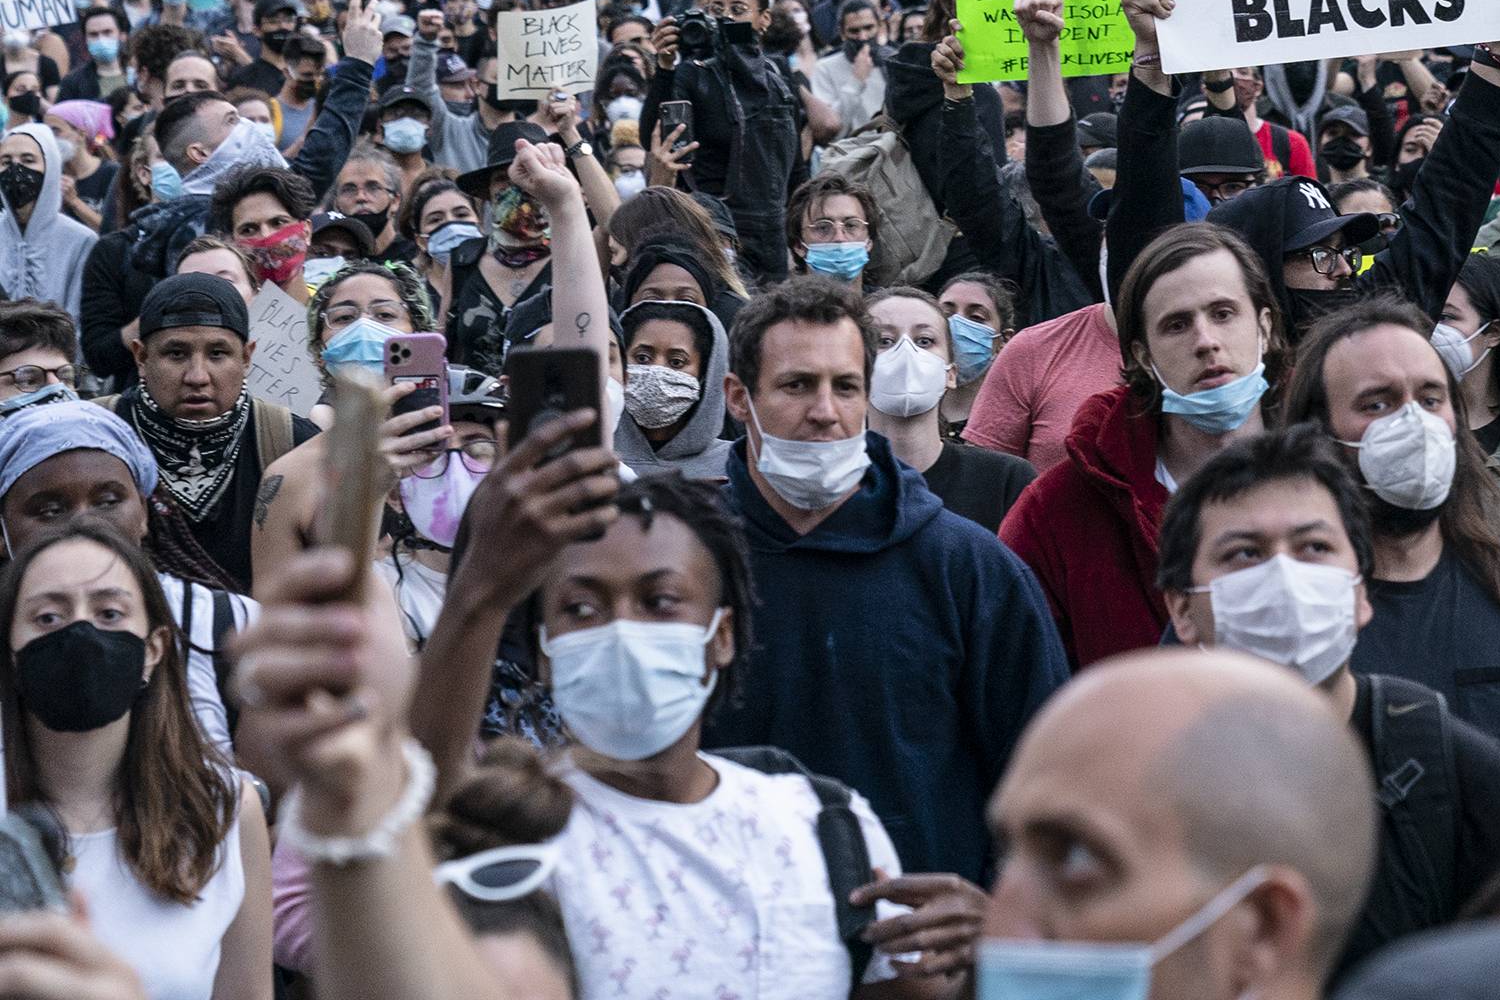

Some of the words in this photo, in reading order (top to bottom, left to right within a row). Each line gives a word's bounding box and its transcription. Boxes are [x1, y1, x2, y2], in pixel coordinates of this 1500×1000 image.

[520, 13, 580, 37] BLACK
[524, 34, 583, 58] LIVES
[507, 59, 592, 88] MATTER
[258, 299, 309, 344] BLAC
[244, 363, 299, 406] TTER
